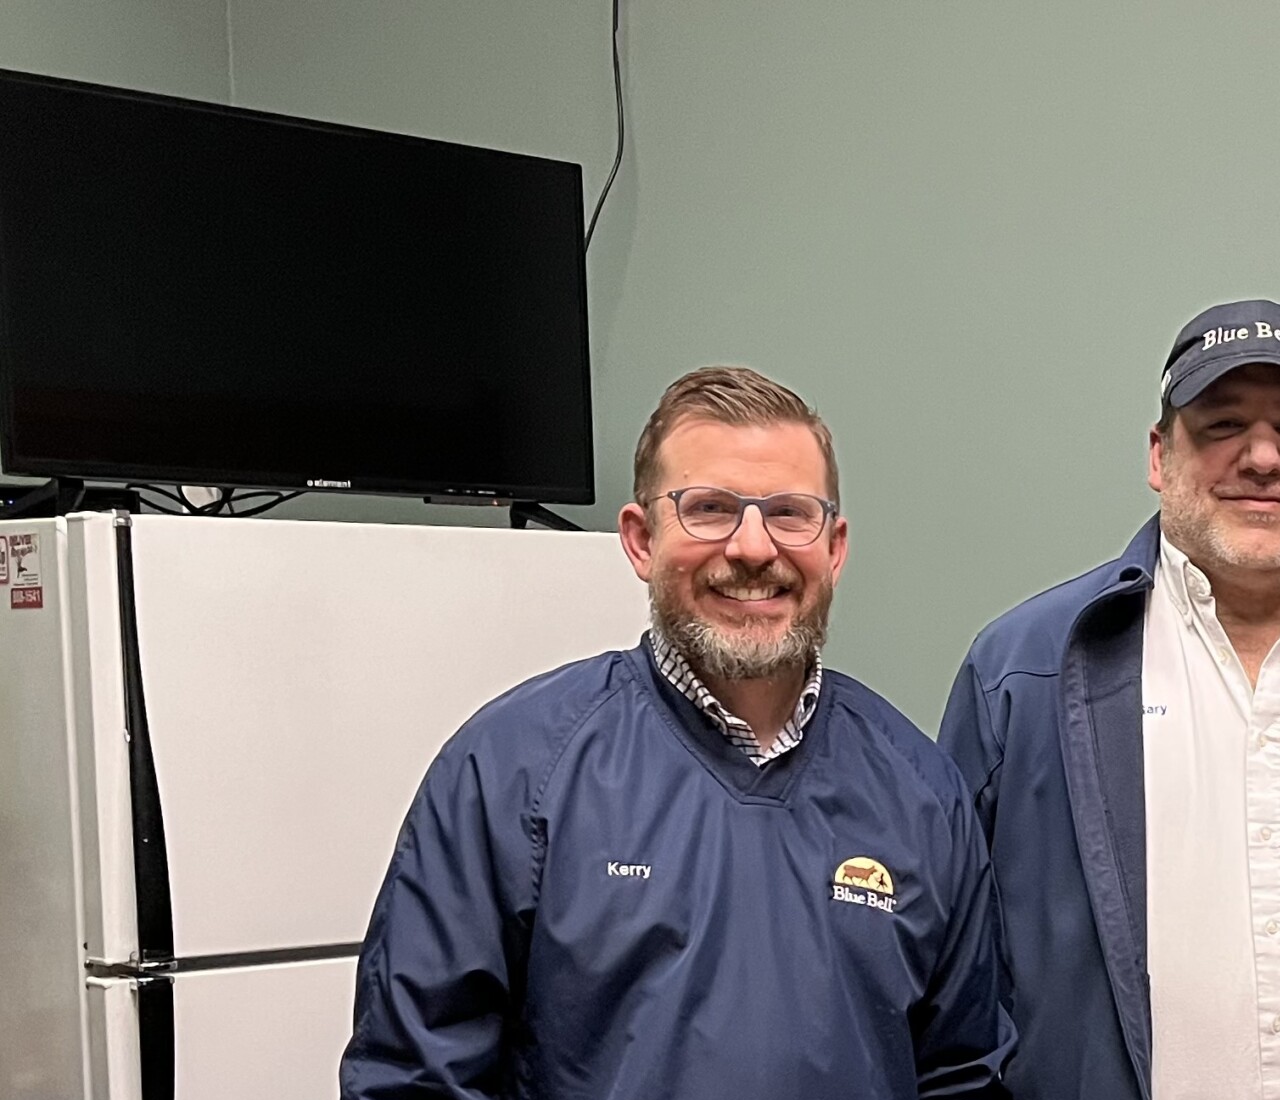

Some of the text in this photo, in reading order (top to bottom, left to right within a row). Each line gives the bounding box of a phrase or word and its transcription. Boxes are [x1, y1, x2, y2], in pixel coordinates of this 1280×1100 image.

[1202, 327, 1249, 351] Blue
[607, 861, 651, 879] Kerry
[832, 885, 894, 913] Blue Bell
